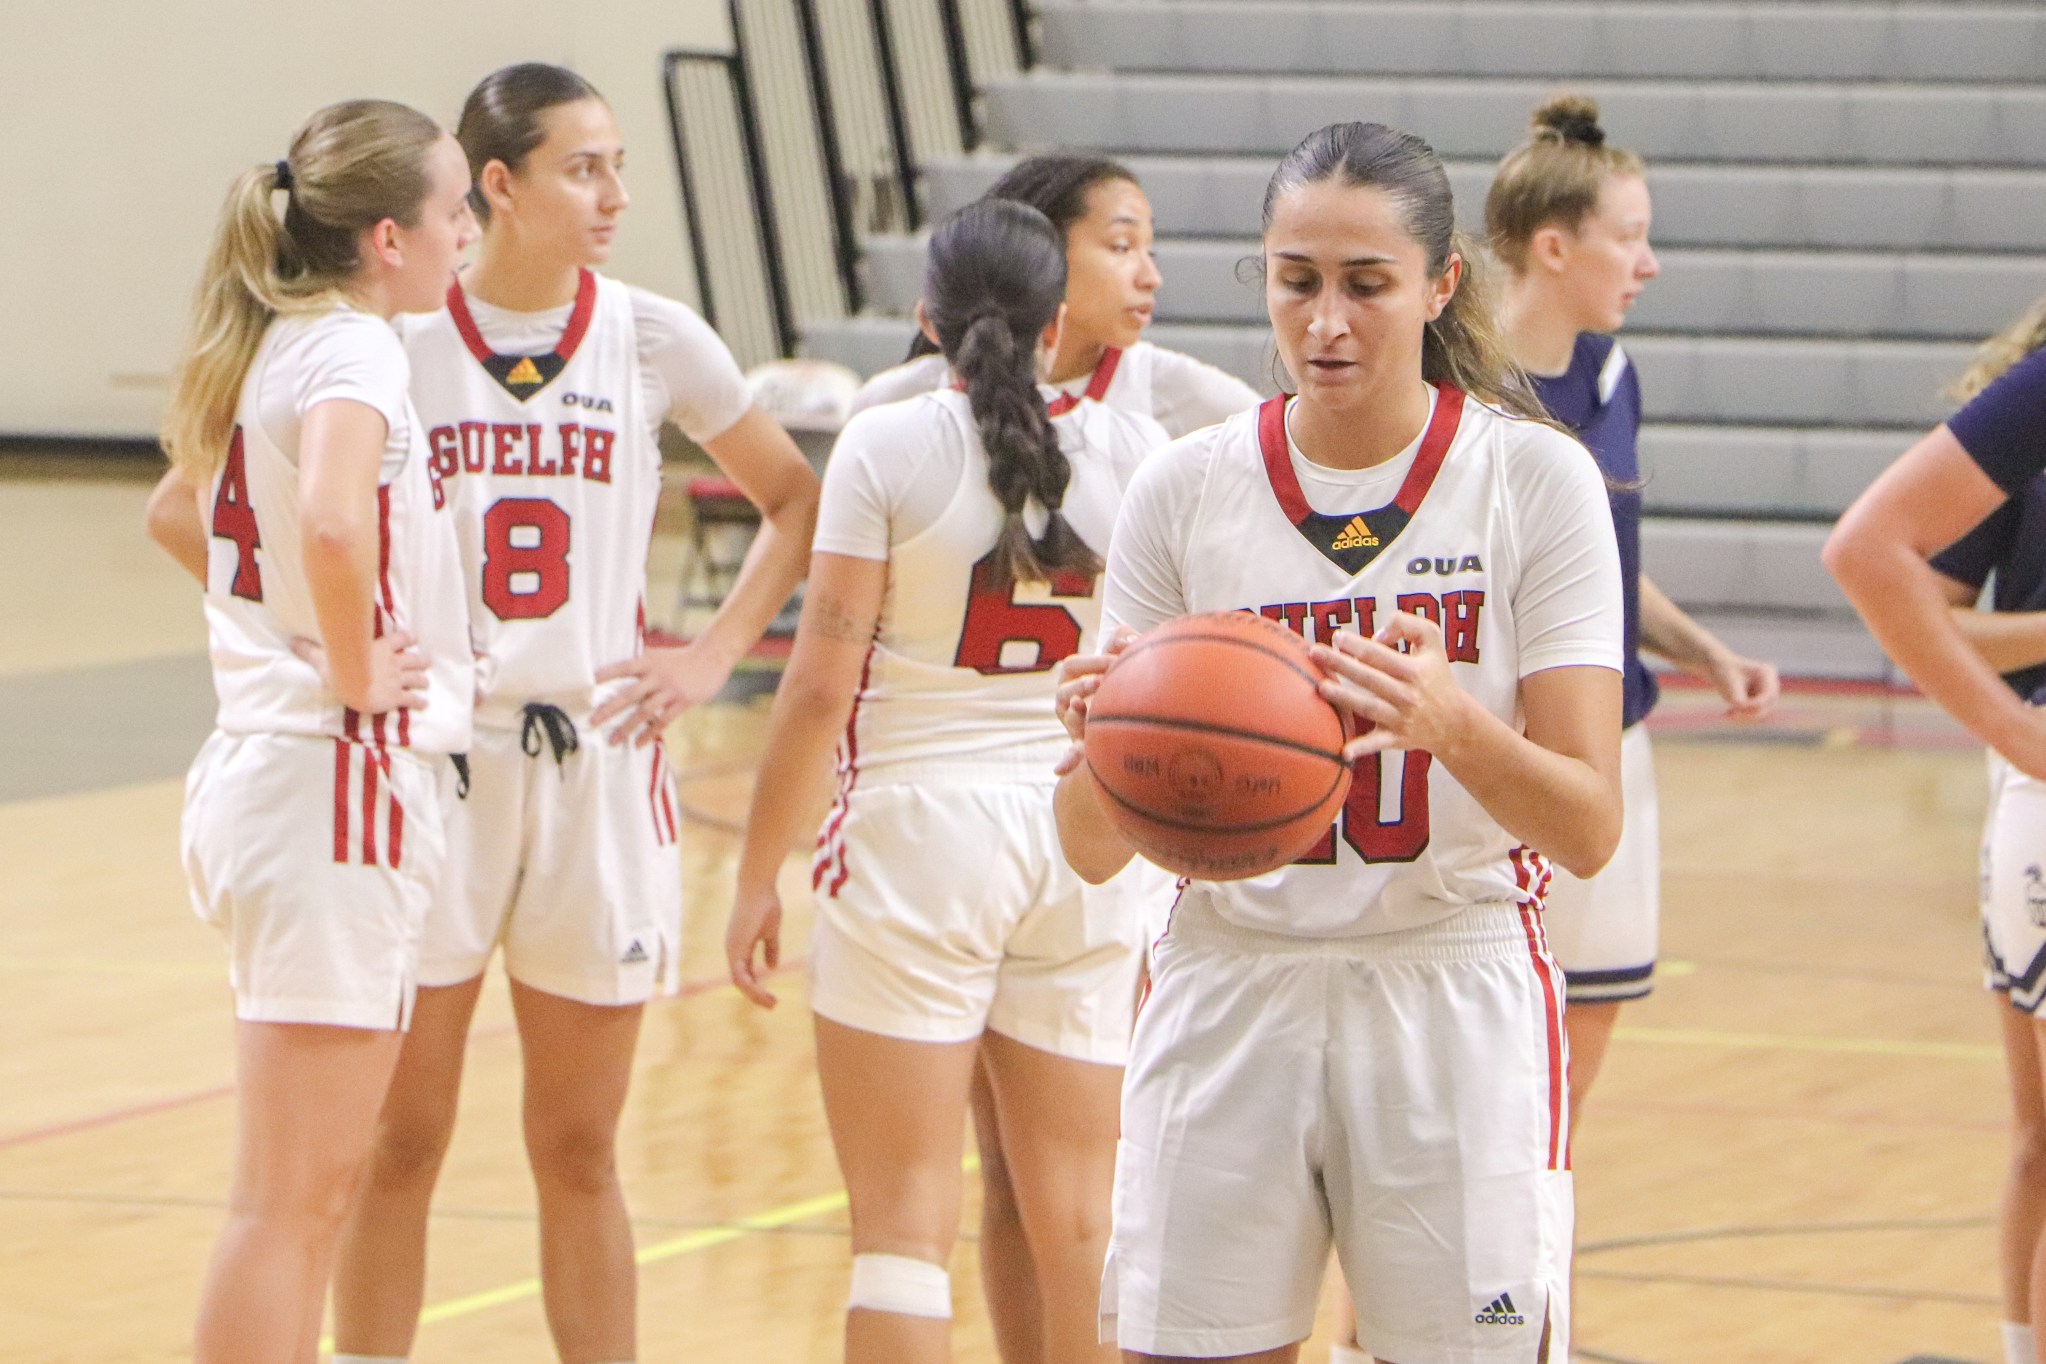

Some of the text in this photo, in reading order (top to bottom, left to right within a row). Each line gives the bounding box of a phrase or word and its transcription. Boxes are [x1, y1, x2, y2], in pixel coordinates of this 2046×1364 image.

[562, 392, 613, 413] OUA
[428, 421, 616, 484] GUELPH
[1332, 535, 1380, 550] adidas
[483, 498, 571, 621] 8
[1406, 554, 1485, 577] OUA
[953, 551, 1097, 676] 6
[1475, 1312, 1524, 1326] adidas
